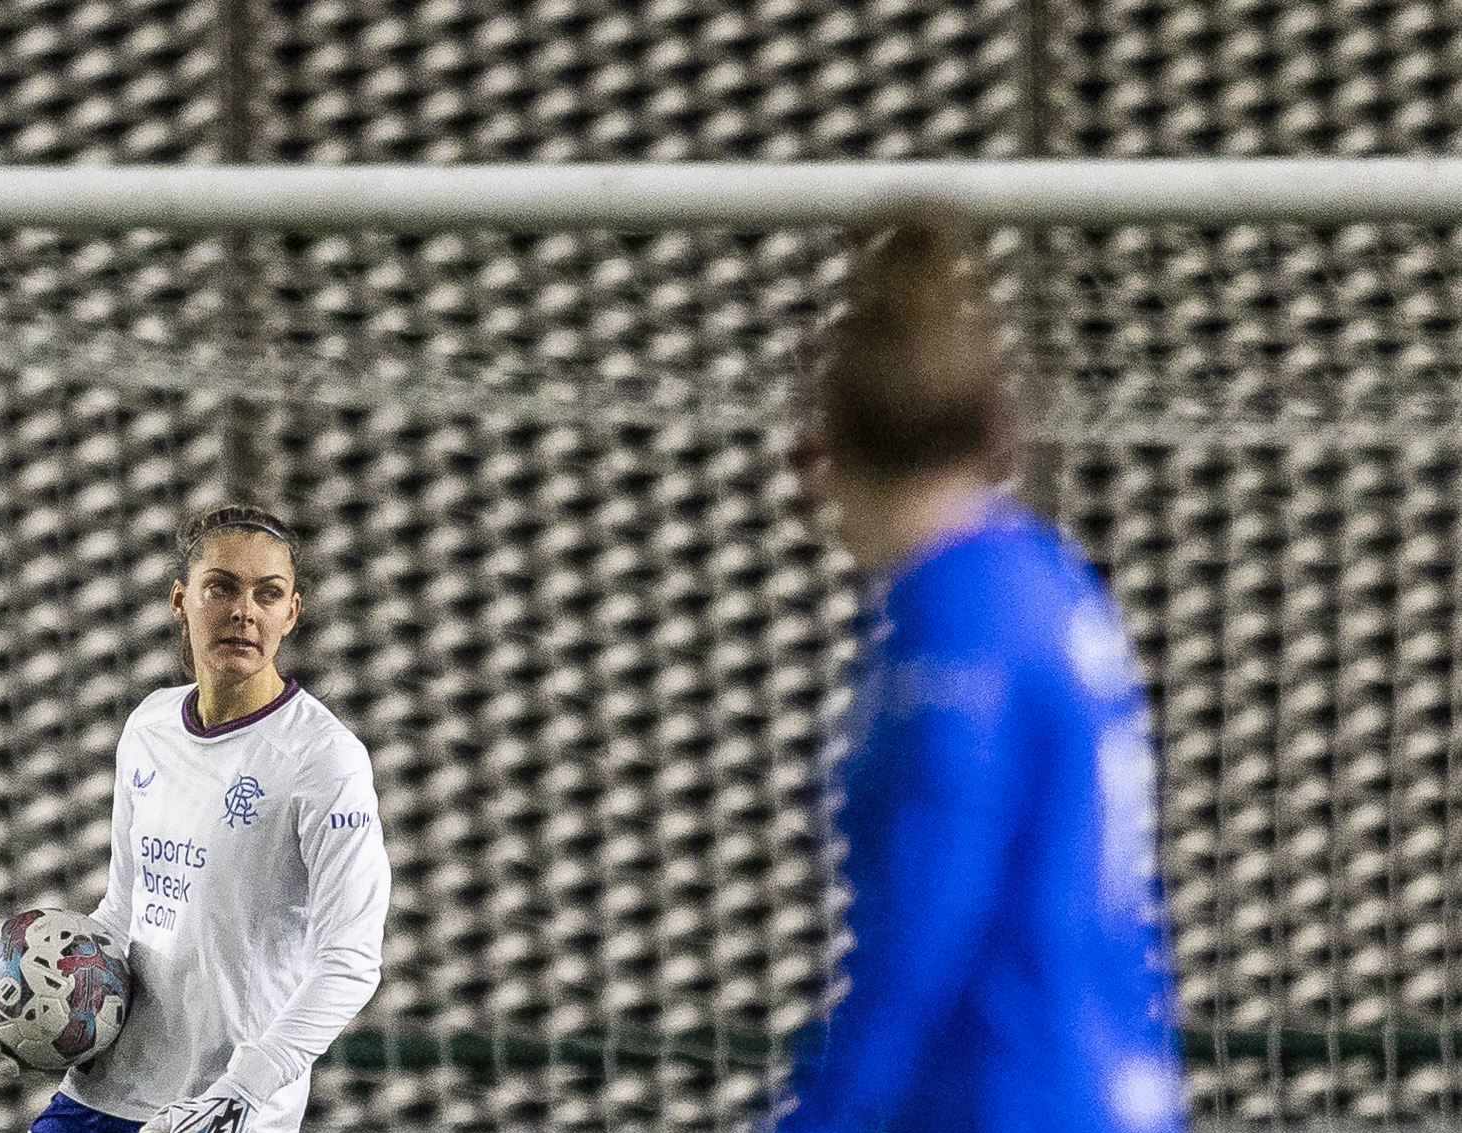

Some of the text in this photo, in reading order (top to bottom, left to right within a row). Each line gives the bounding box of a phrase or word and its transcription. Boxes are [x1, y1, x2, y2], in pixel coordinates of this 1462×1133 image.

[142, 836, 207, 869] sports
[143, 865, 191, 903] break
[142, 903, 177, 931] .com
